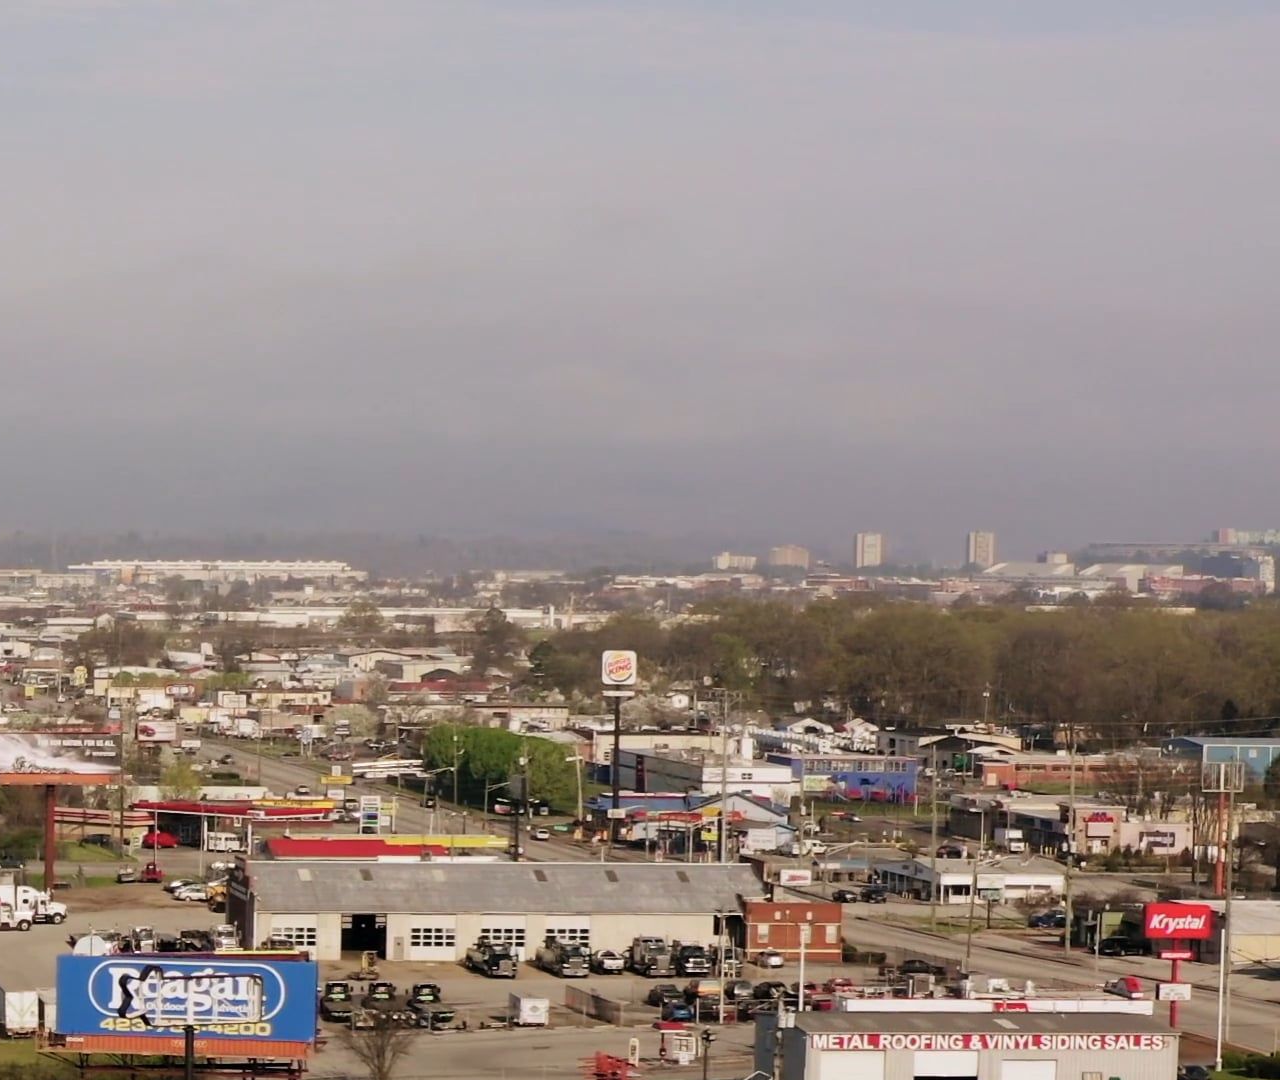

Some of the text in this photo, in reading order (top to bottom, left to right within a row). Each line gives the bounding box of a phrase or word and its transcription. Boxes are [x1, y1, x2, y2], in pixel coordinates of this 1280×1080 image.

[608, 662, 632, 675] KING
[1149, 914, 1206, 934] Krystal
[812, 1034, 1164, 1050] METAL ROOFING & VINYL SIDING SALES
